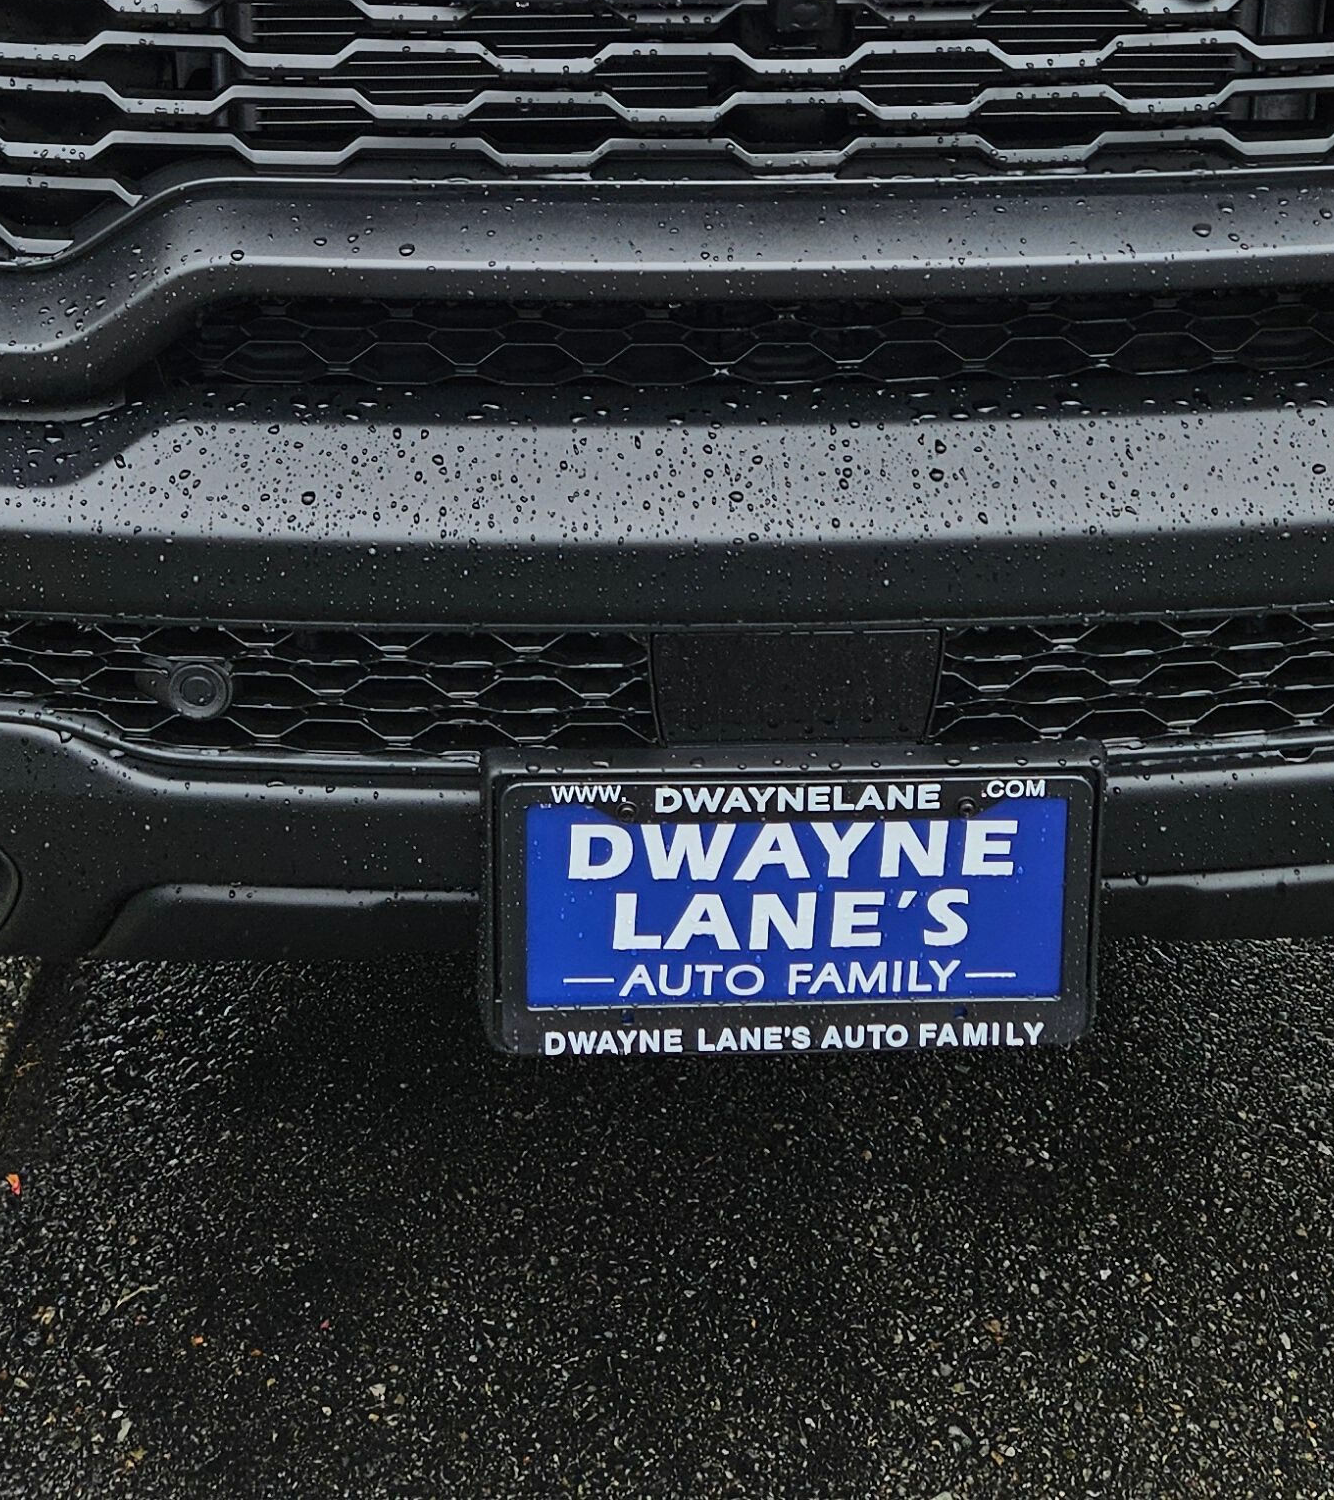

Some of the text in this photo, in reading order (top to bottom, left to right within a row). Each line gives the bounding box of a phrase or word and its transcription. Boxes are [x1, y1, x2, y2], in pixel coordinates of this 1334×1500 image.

[654, 783, 942, 814] DWAYNELANE
[567, 819, 1020, 881] DWAYNE
[611, 887, 971, 952] LANE'S
[619, 959, 962, 997] AUTO FAMILY
[544, 1021, 1045, 1056] DWAYNE LANE'S AUTO FAMILY
